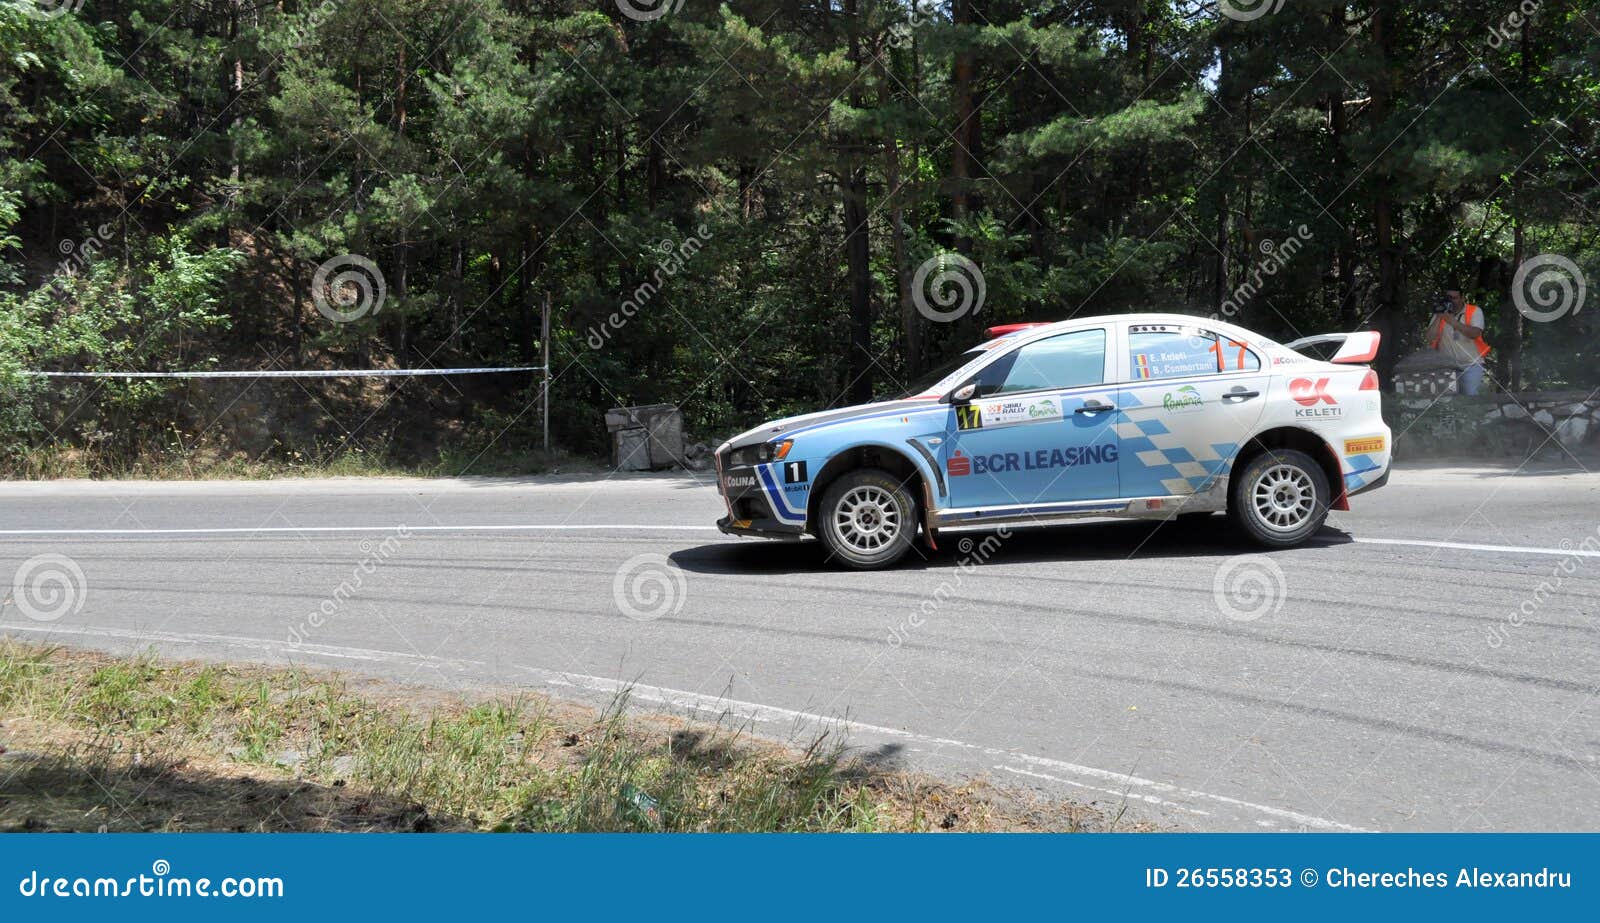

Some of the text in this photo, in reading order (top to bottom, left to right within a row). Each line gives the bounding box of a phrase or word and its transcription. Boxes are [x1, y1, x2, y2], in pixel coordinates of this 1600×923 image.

[1208, 340, 1248, 370] 17
[958, 404, 981, 429] 17
[1295, 407, 1342, 417] KELETI
[973, 452, 1020, 474] BCR
[1025, 444, 1118, 470] LEASING
